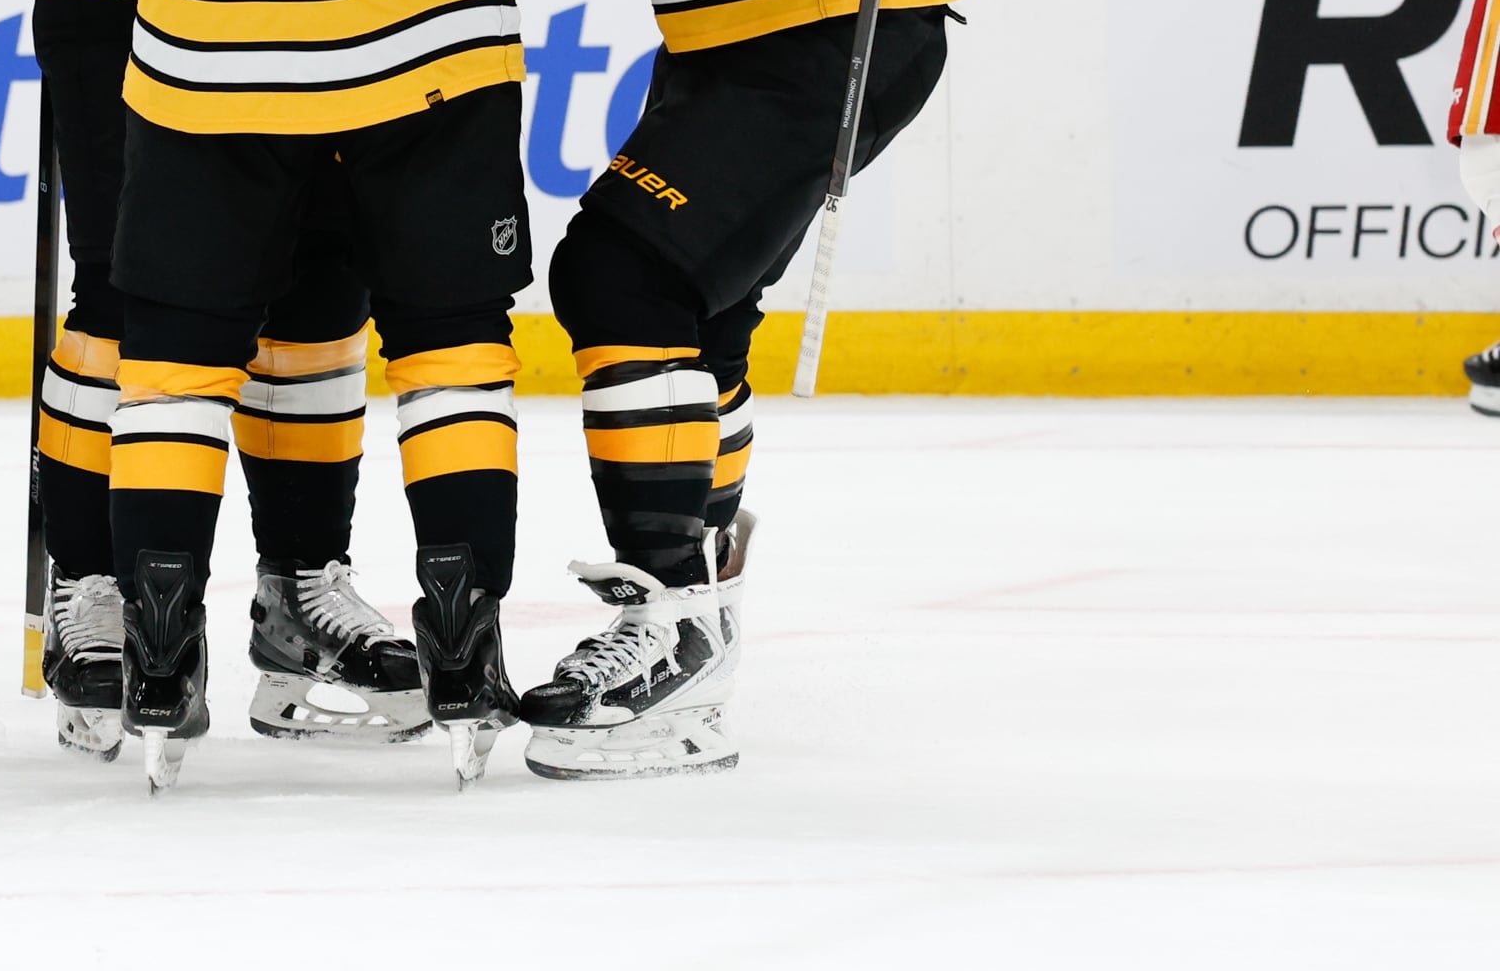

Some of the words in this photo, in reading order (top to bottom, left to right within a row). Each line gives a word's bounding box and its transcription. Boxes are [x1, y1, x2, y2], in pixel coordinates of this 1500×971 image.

[610, 154, 689, 211] AUER
[611, 584, 638, 599] 88
[138, 706, 172, 717] CCM
[437, 701, 469, 712] CCM
